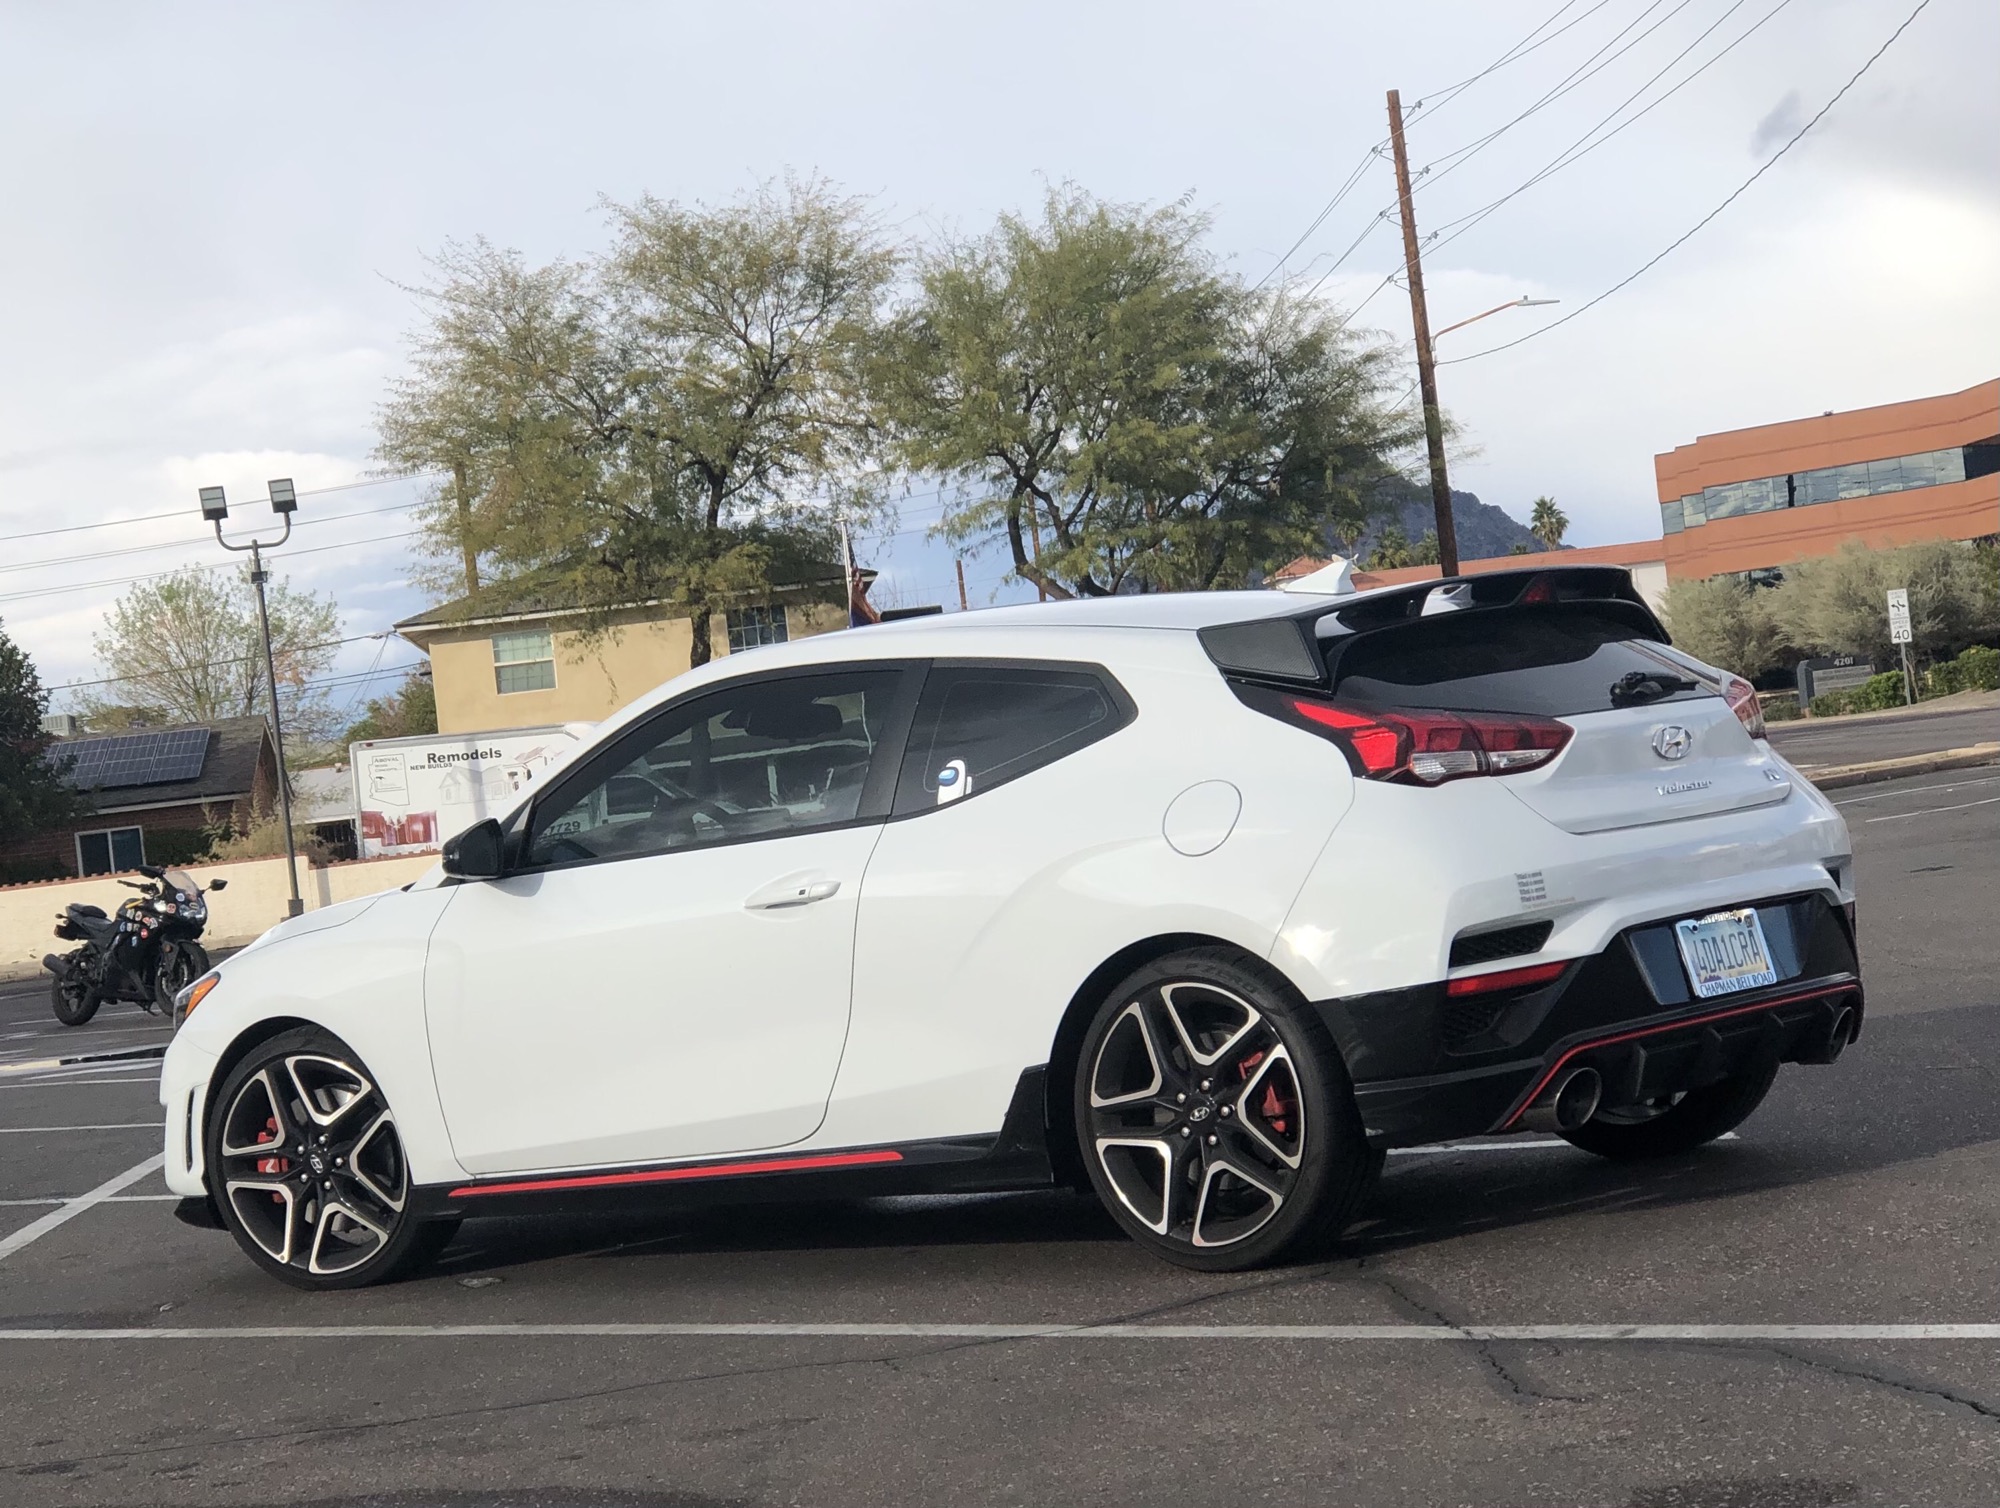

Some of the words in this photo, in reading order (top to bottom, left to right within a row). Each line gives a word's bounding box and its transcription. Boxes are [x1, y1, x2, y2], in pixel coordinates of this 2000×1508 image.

[1894, 629, 1910, 641] 40
[1834, 656, 1854, 667] 4201
[426, 747, 503, 764] Remodels
[427, 762, 453, 770] BUILDS
[1693, 929, 1763, 974] 4DA1CRA
[1700, 979, 1737, 997] CHAPMAN
[1735, 975, 1754, 990] BELL
[1752, 971, 1775, 985] ROAD
